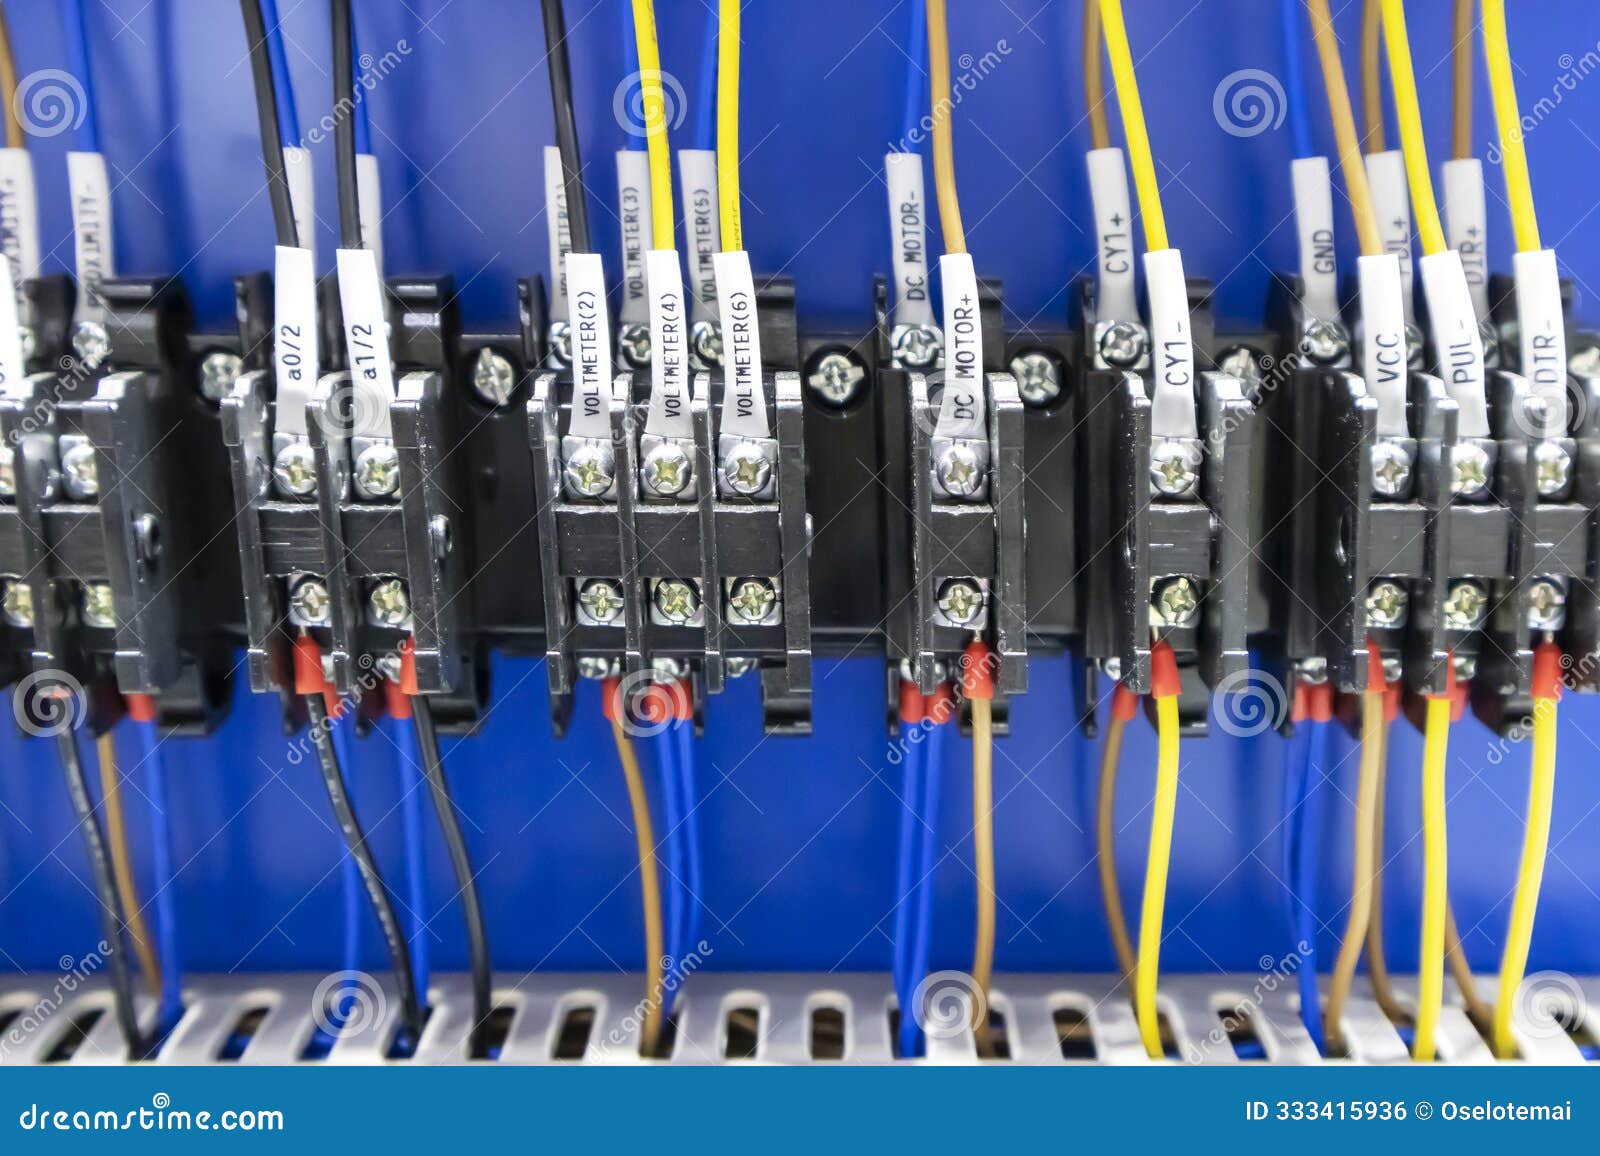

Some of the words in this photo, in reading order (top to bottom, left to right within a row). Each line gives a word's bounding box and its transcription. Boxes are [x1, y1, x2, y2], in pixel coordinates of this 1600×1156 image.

[622, 186, 645, 299] VOLTMETER(3)
[900, 191, 922, 264] MOTOR-
[1105, 213, 1129, 274] CY1+
[1313, 230, 1335, 275] GND
[906, 275, 926, 301] DC
[281, 324, 301, 381] a0/2
[352, 323, 377, 380] a1/2
[577, 291, 600, 417] VOLTMETER(2)
[661, 293, 681, 418] VOLTMETER(4)
[730, 292, 753, 418] VOLTMETER(6)
[953, 294, 976, 379] MOTOR+
[1376, 333, 1400, 383] VCC
[955, 394, 975, 420] DC
